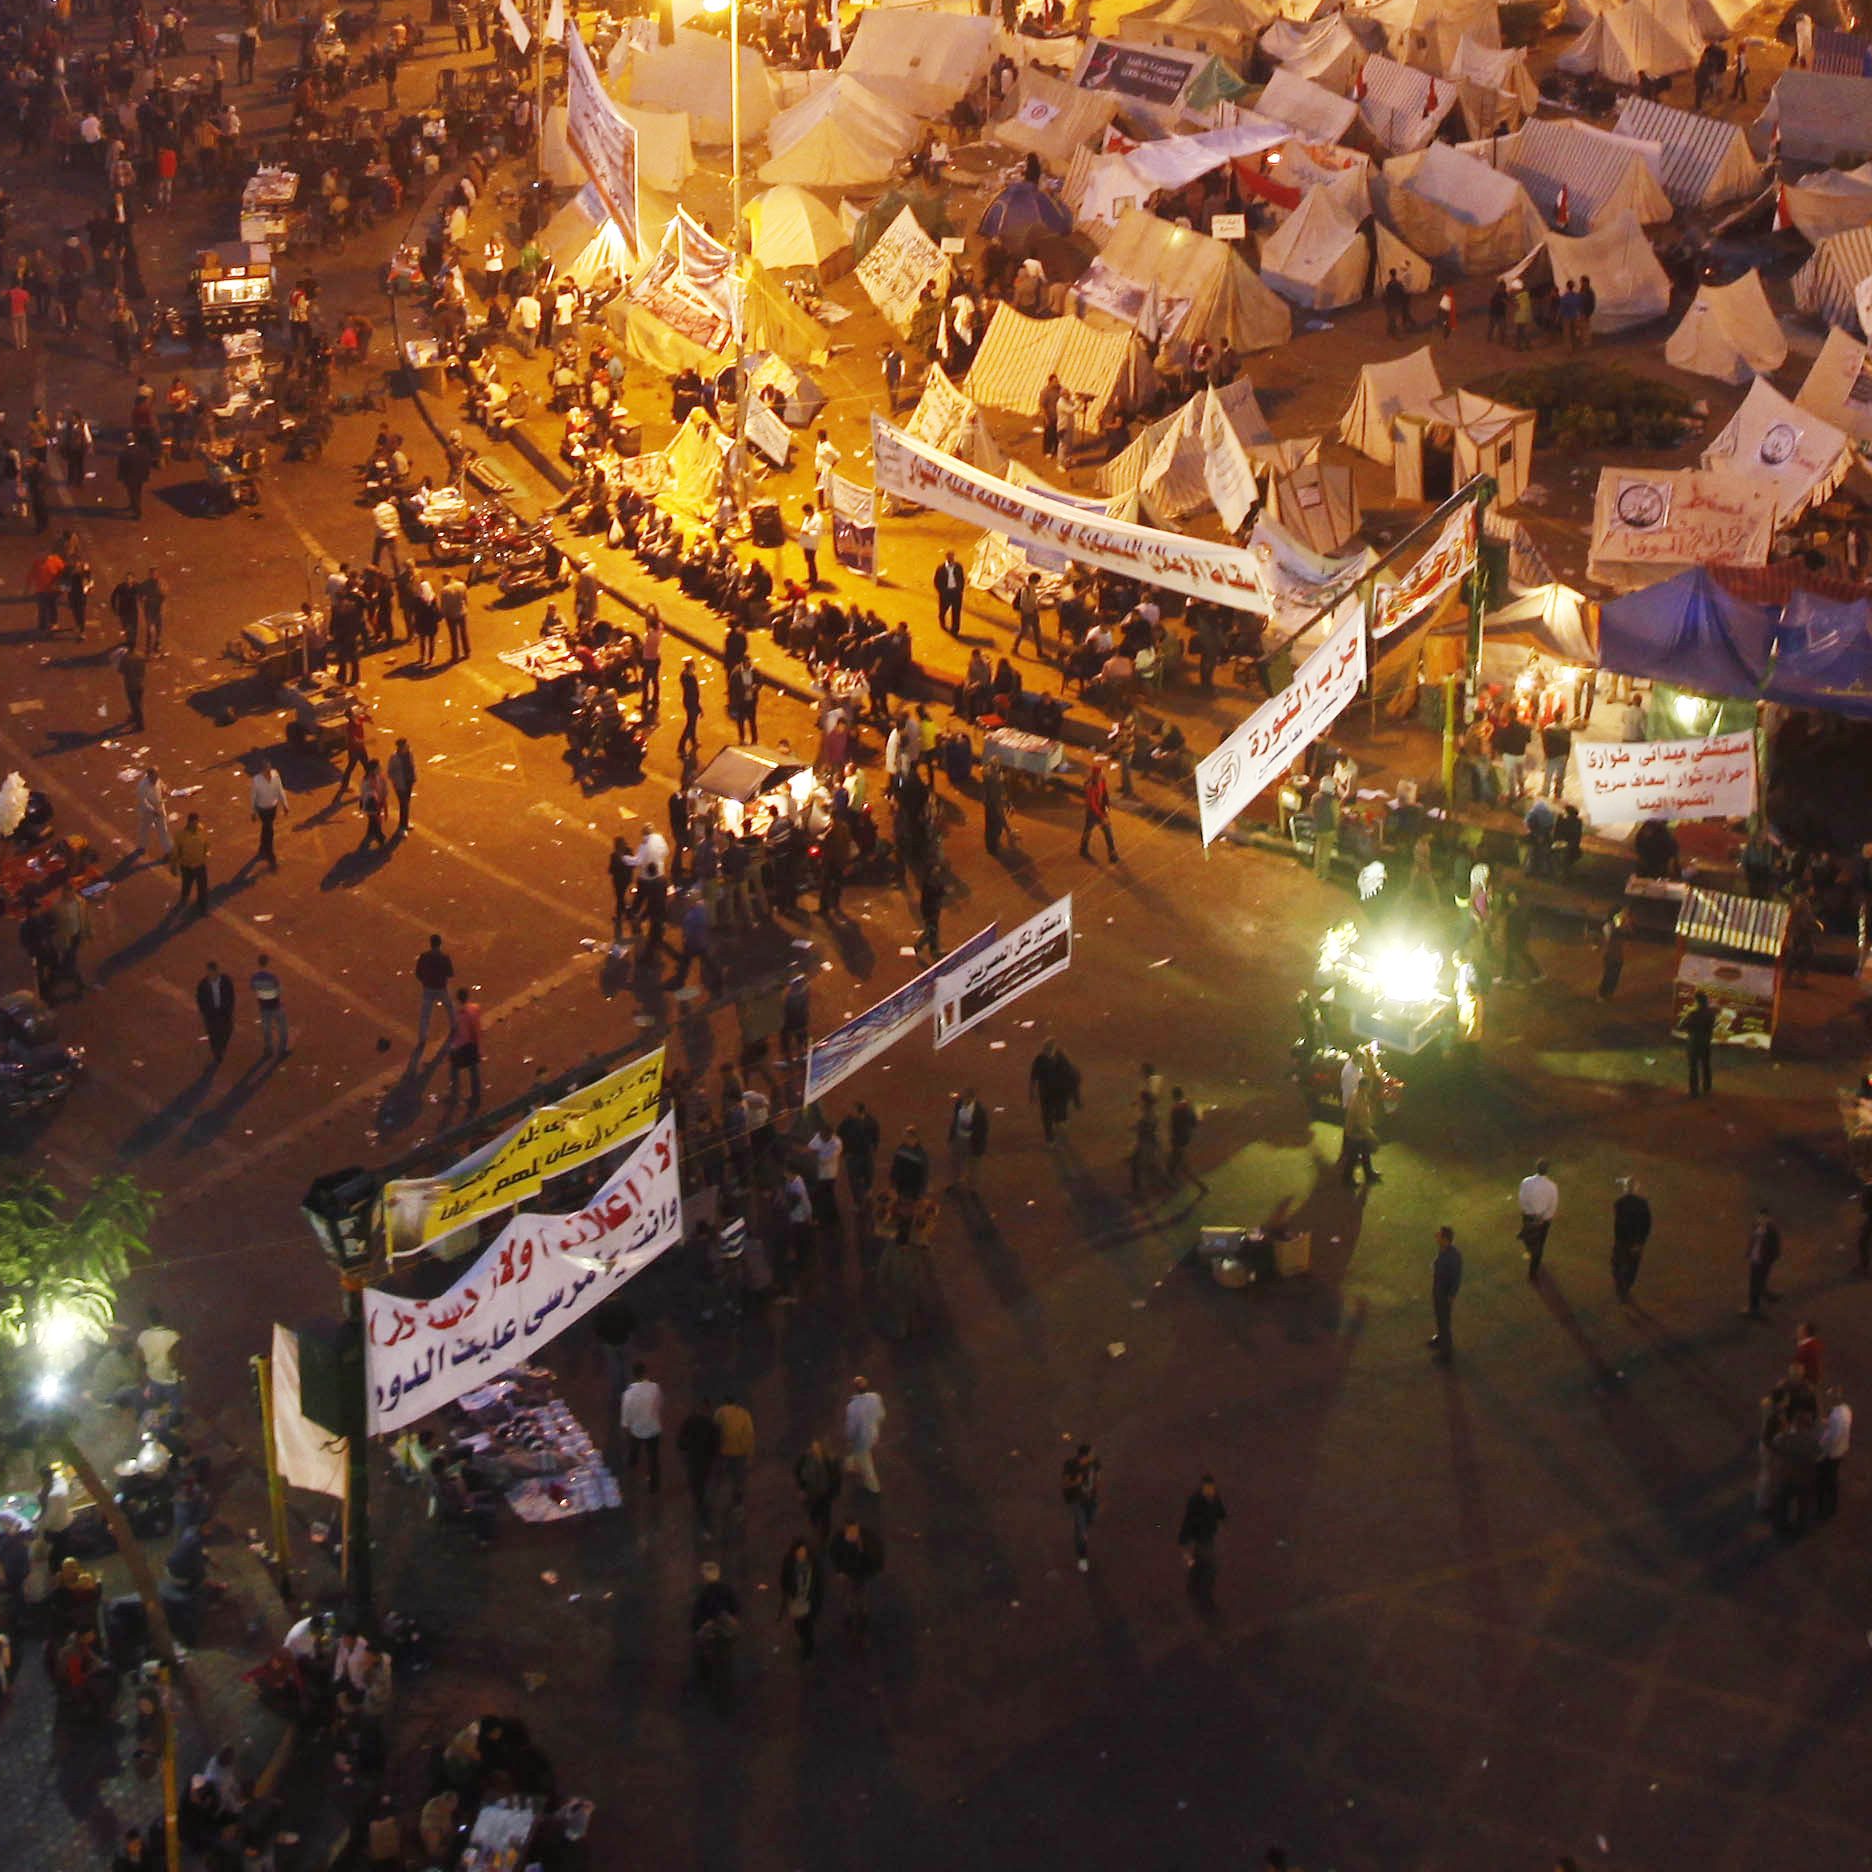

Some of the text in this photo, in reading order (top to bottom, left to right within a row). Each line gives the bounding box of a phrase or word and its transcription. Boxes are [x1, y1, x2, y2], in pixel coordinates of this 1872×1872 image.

[1315, 637, 1358, 692] حزب
[1249, 681, 1310, 759] الثورة
[1033, 914, 1062, 945] دستور
